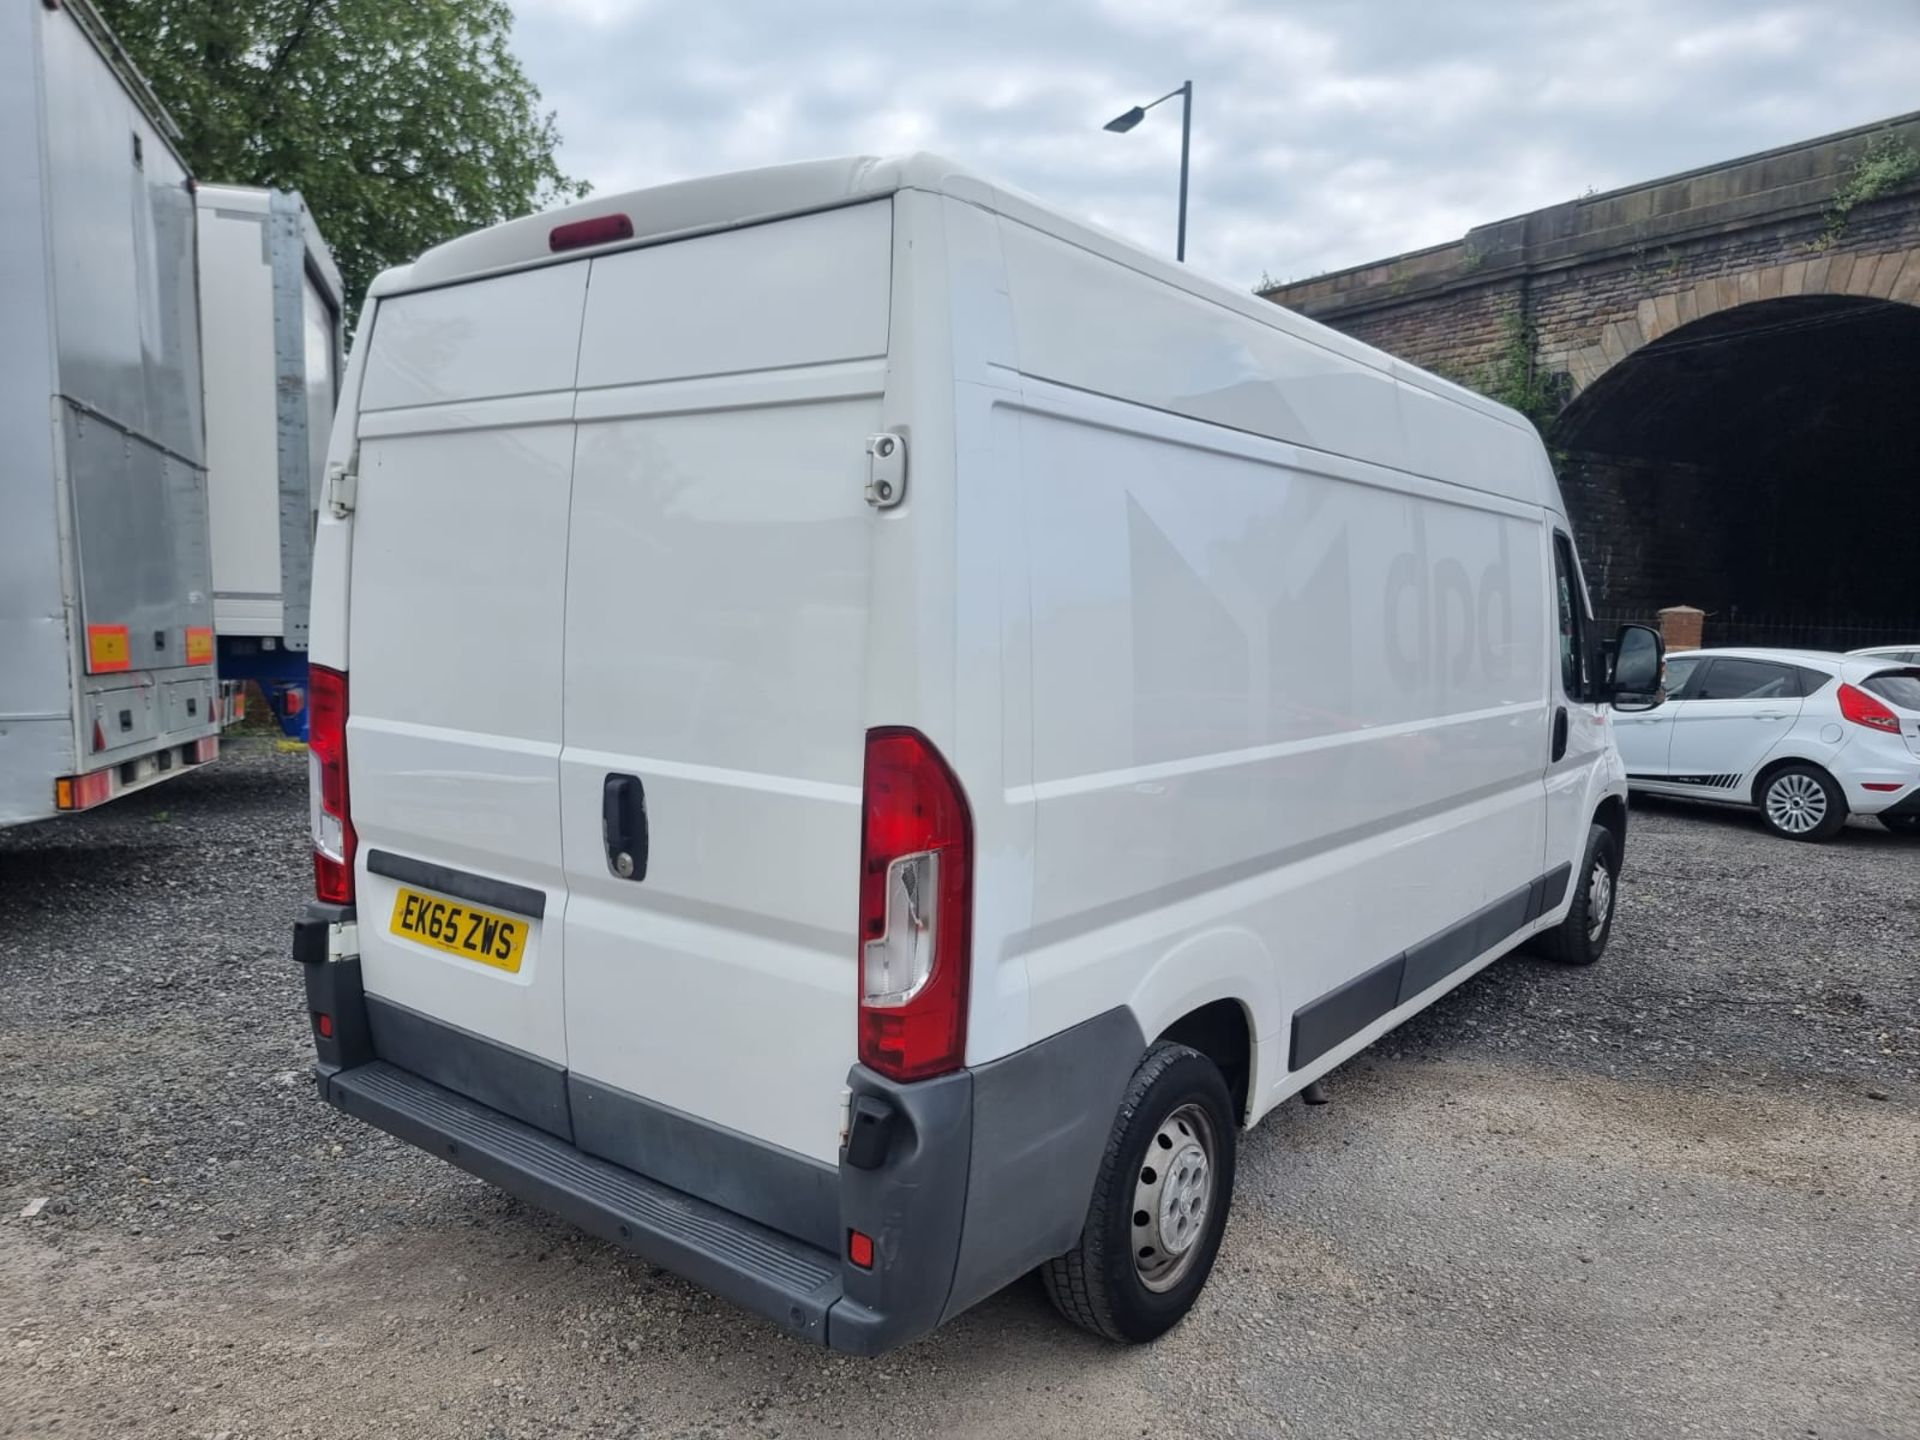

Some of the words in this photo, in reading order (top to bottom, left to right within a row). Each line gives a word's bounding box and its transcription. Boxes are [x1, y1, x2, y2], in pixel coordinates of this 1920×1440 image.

[1384, 498, 1512, 707] dpd
[401, 894, 462, 944] EK65
[463, 913, 515, 960] ZWS
